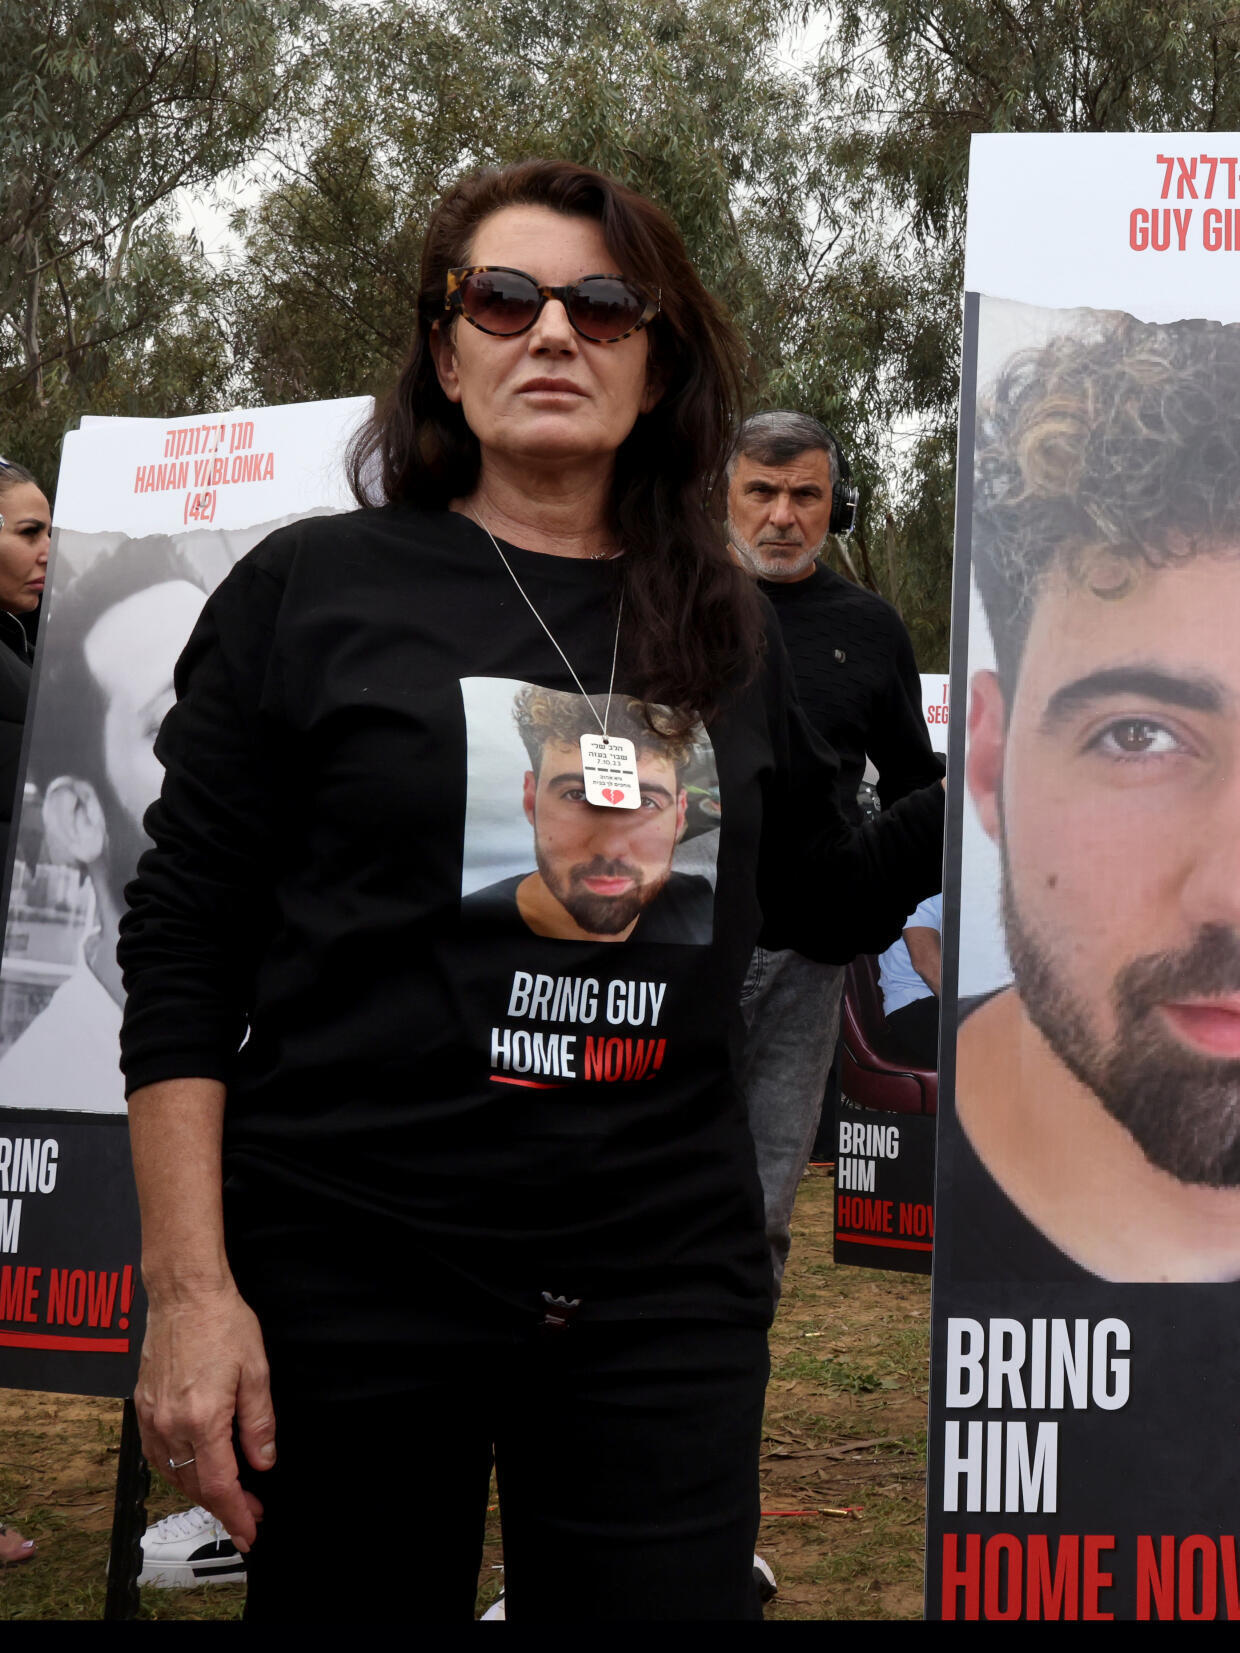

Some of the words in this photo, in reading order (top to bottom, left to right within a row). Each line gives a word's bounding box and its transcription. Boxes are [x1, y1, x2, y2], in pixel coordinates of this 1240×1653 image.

[1129, 208, 1193, 252] GUY
[229, 421, 255, 454] חנן
[134, 461, 190, 494] HANAN
[194, 452, 275, 488] YABLONKA
[183, 489, 217, 525] (42)
[507, 970, 600, 1024] BRING
[606, 979, 667, 1027] GUY
[490, 1027, 577, 1078] HOME
[584, 1035, 667, 1082] NOW!
[839, 1121, 900, 1159] BRING
[838, 1156, 876, 1193] HIM
[837, 1194, 894, 1233] HOME
[46, 1265, 135, 1330] NOW!
[945, 1317, 1131, 1411] BRING
[943, 1420, 1059, 1513] HIM
[941, 1533, 1116, 1620] HOME
